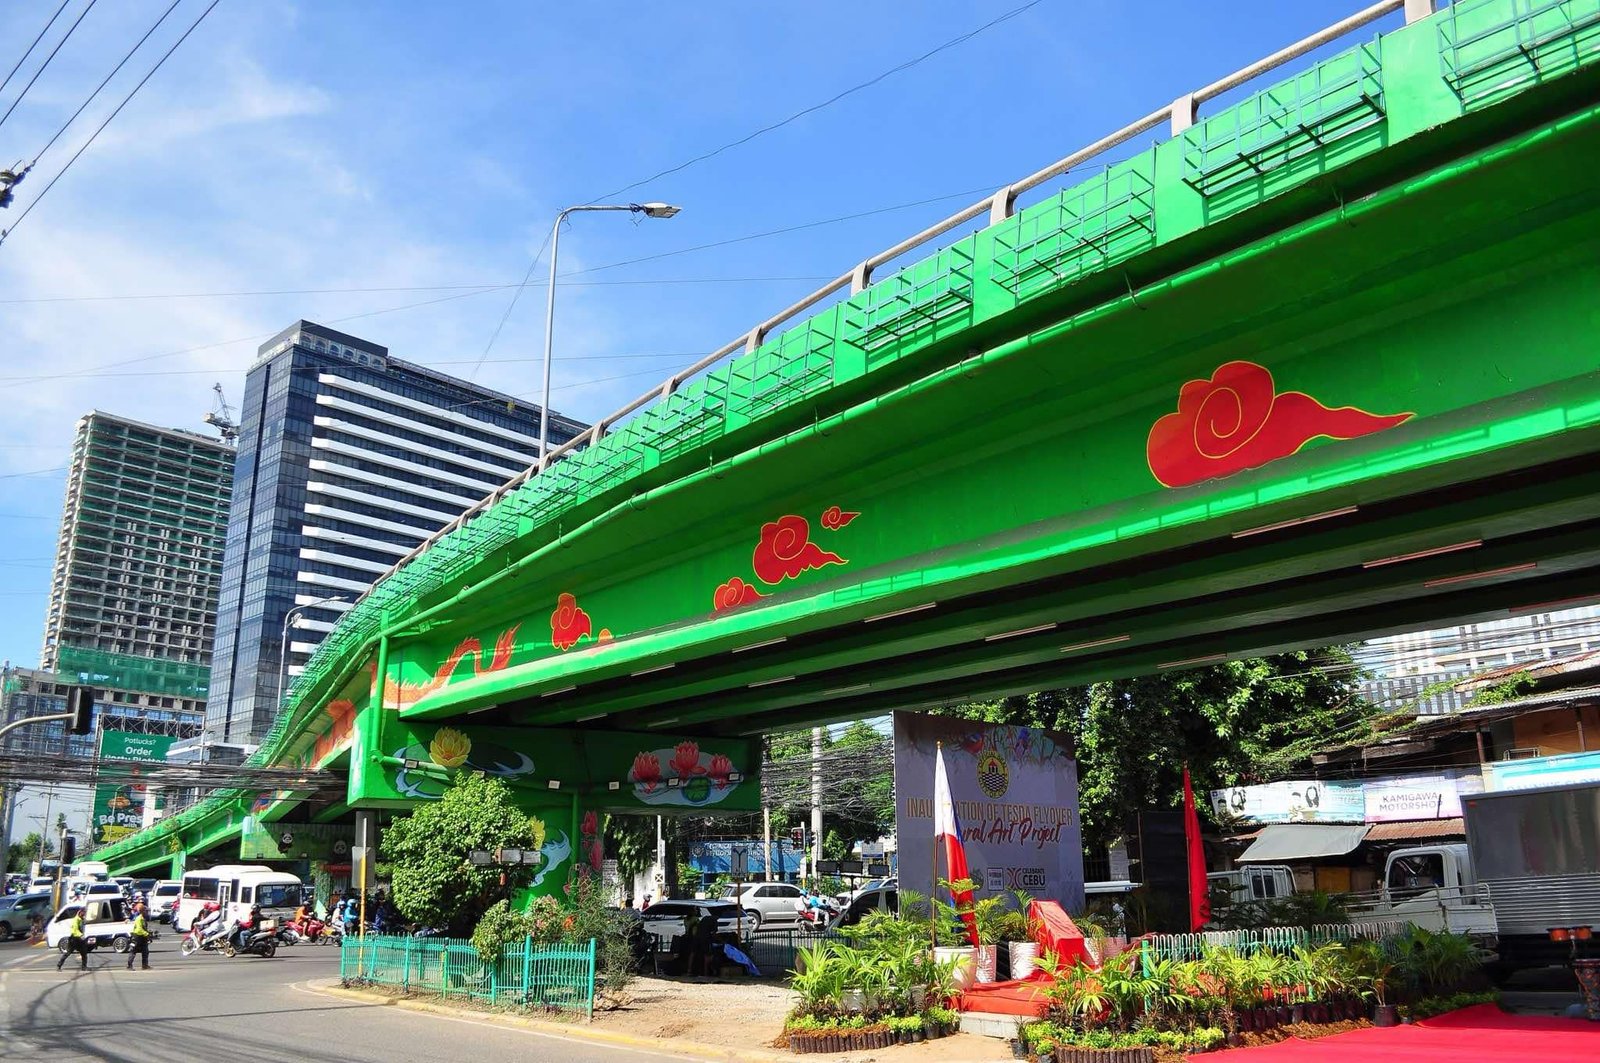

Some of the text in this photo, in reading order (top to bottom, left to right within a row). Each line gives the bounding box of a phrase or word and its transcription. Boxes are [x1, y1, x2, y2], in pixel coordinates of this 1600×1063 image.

[124, 737, 157, 746] Potlucks?
[125, 746, 153, 756] Order
[1382, 792, 1438, 803] KAMIGAWA
[99, 815, 116, 825] Be
[987, 803, 1000, 821] OF
[1001, 803, 1031, 823] TESDA
[1033, 806, 1073, 826] FLYOVER
[987, 817, 1019, 845] Art
[1018, 817, 1067, 849] Project
[1022, 874, 1046, 886] CEBU
